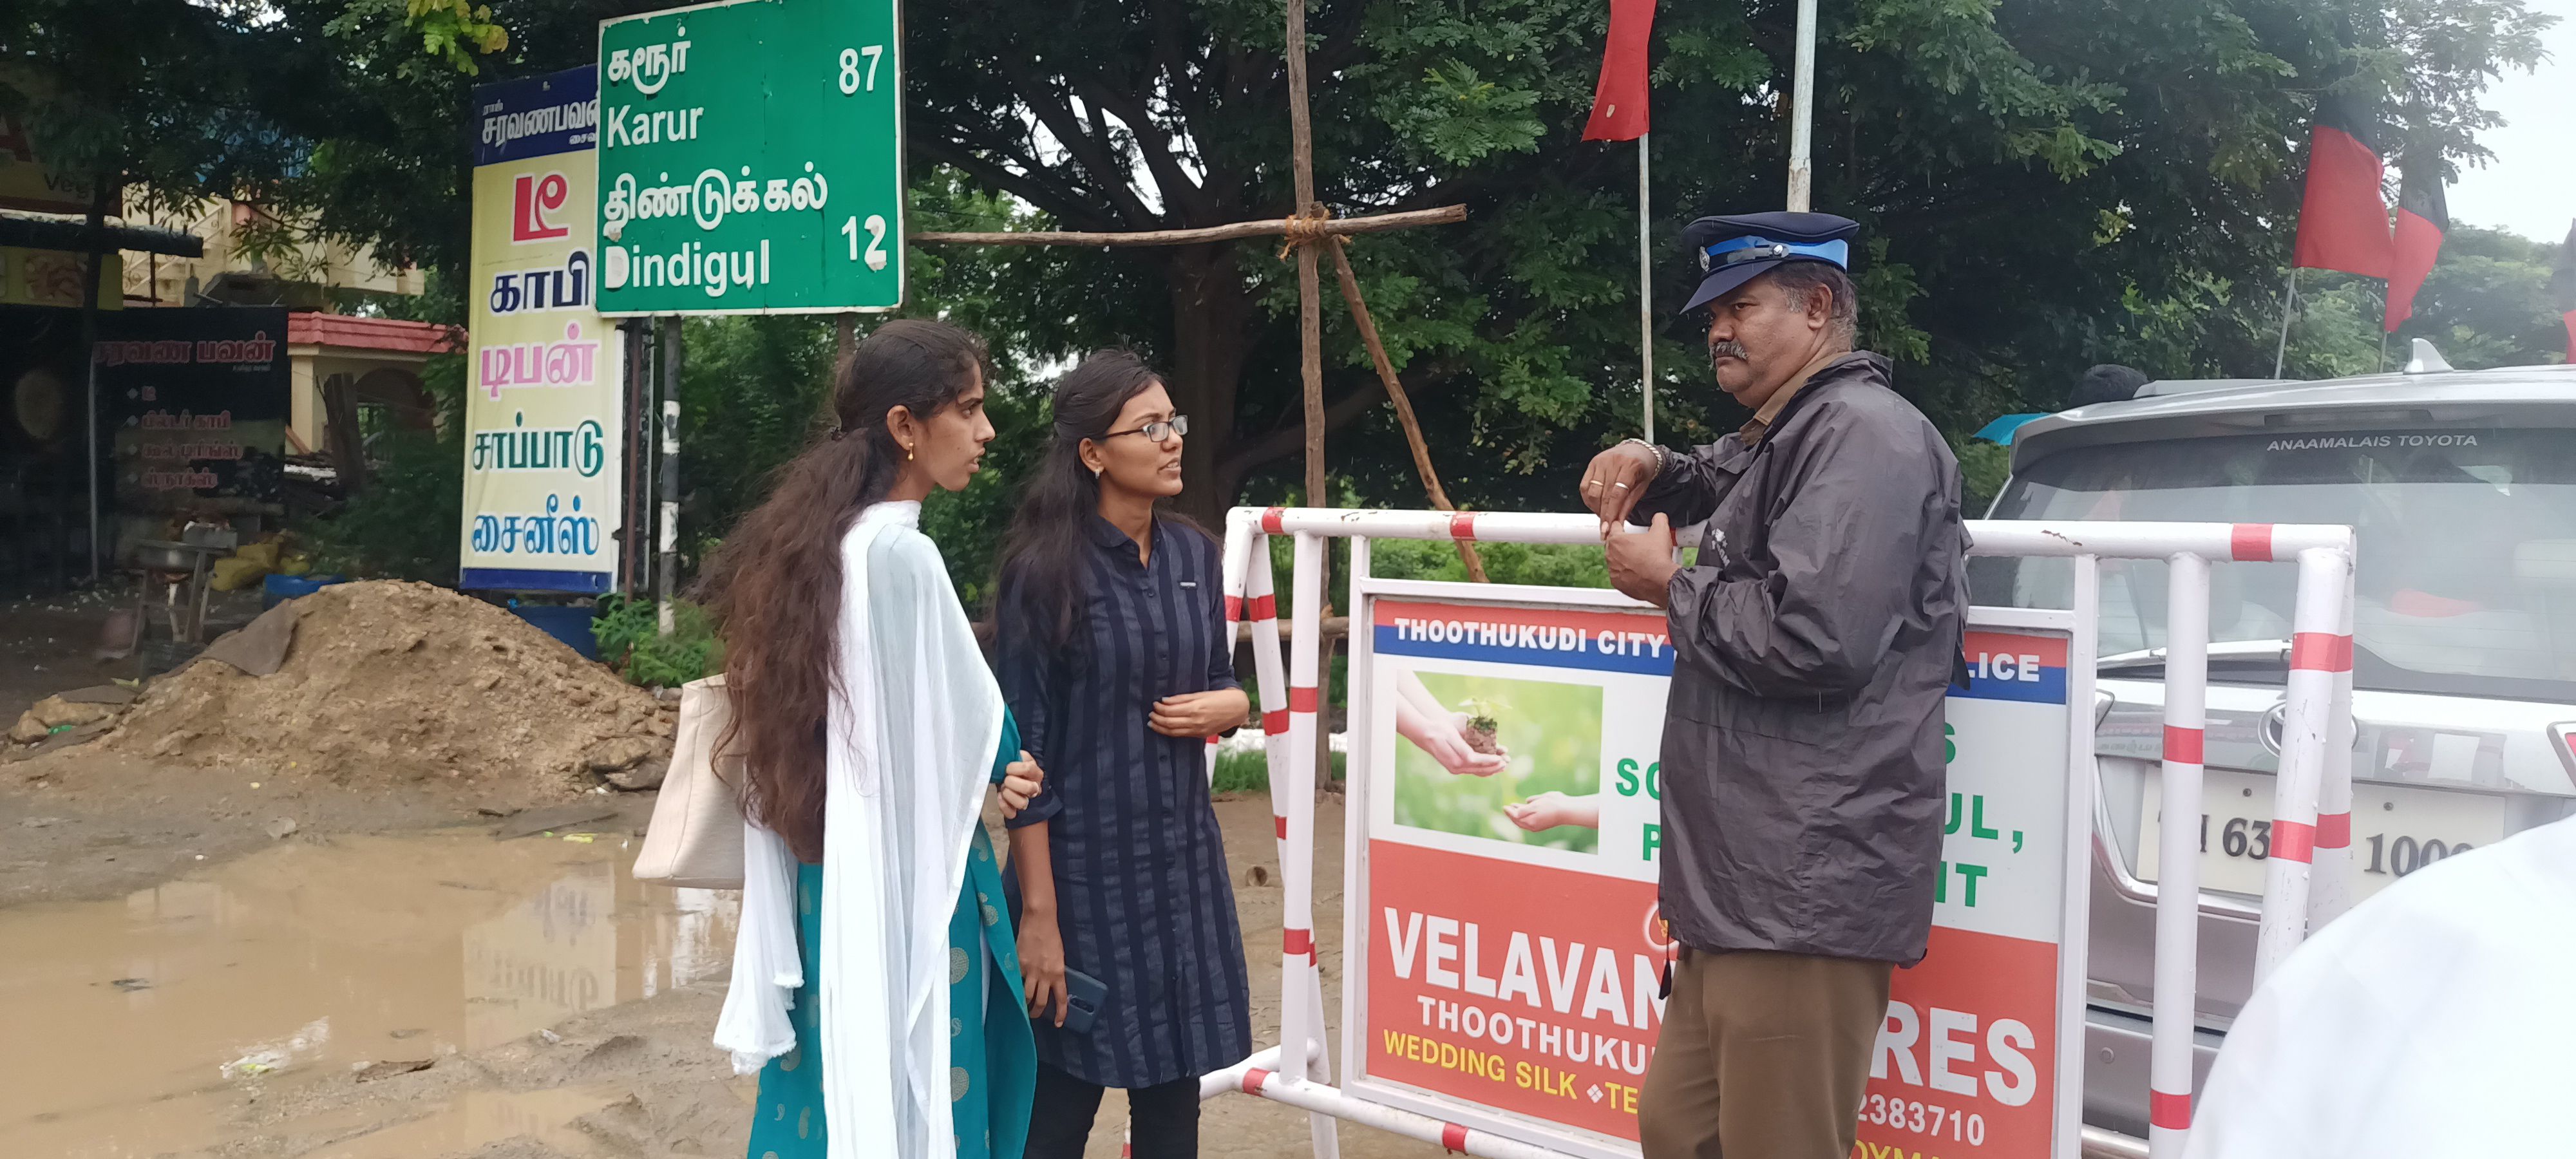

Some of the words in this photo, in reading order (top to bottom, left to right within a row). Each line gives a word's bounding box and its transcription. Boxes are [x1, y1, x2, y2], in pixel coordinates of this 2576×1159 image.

[608, 26, 691, 95] கரூர்
[839, 46, 882, 95] 87
[607, 104, 704, 147] Karur
[513, 172, 569, 241] டீ
[604, 162, 828, 240] திண்டுக்கல்
[605, 239, 770, 297] Dindigul
[841, 214, 887, 271] 12
[491, 251, 589, 313] காபி
[196, 330, 276, 363] பவன்
[480, 323, 598, 397] டிபன்
[473, 411, 604, 477] சாப்பாடு
[2266, 435, 2391, 451] ANAAMALAIS
[2398, 435, 2478, 447] TOYOTA
[471, 494, 600, 556] சைனீஸ்
[1394, 617, 1587, 652] THOOTHUKUDI
[1597, 630, 1667, 658] CITY
[2222, 817, 2271, 860] 63
[1383, 906, 1676, 1030] VELAVAN
[1383, 1028, 1506, 1083] WEDDING
[1515, 1060, 1578, 1100] SILK
[1417, 994, 1656, 1075] THOOTHUKU
